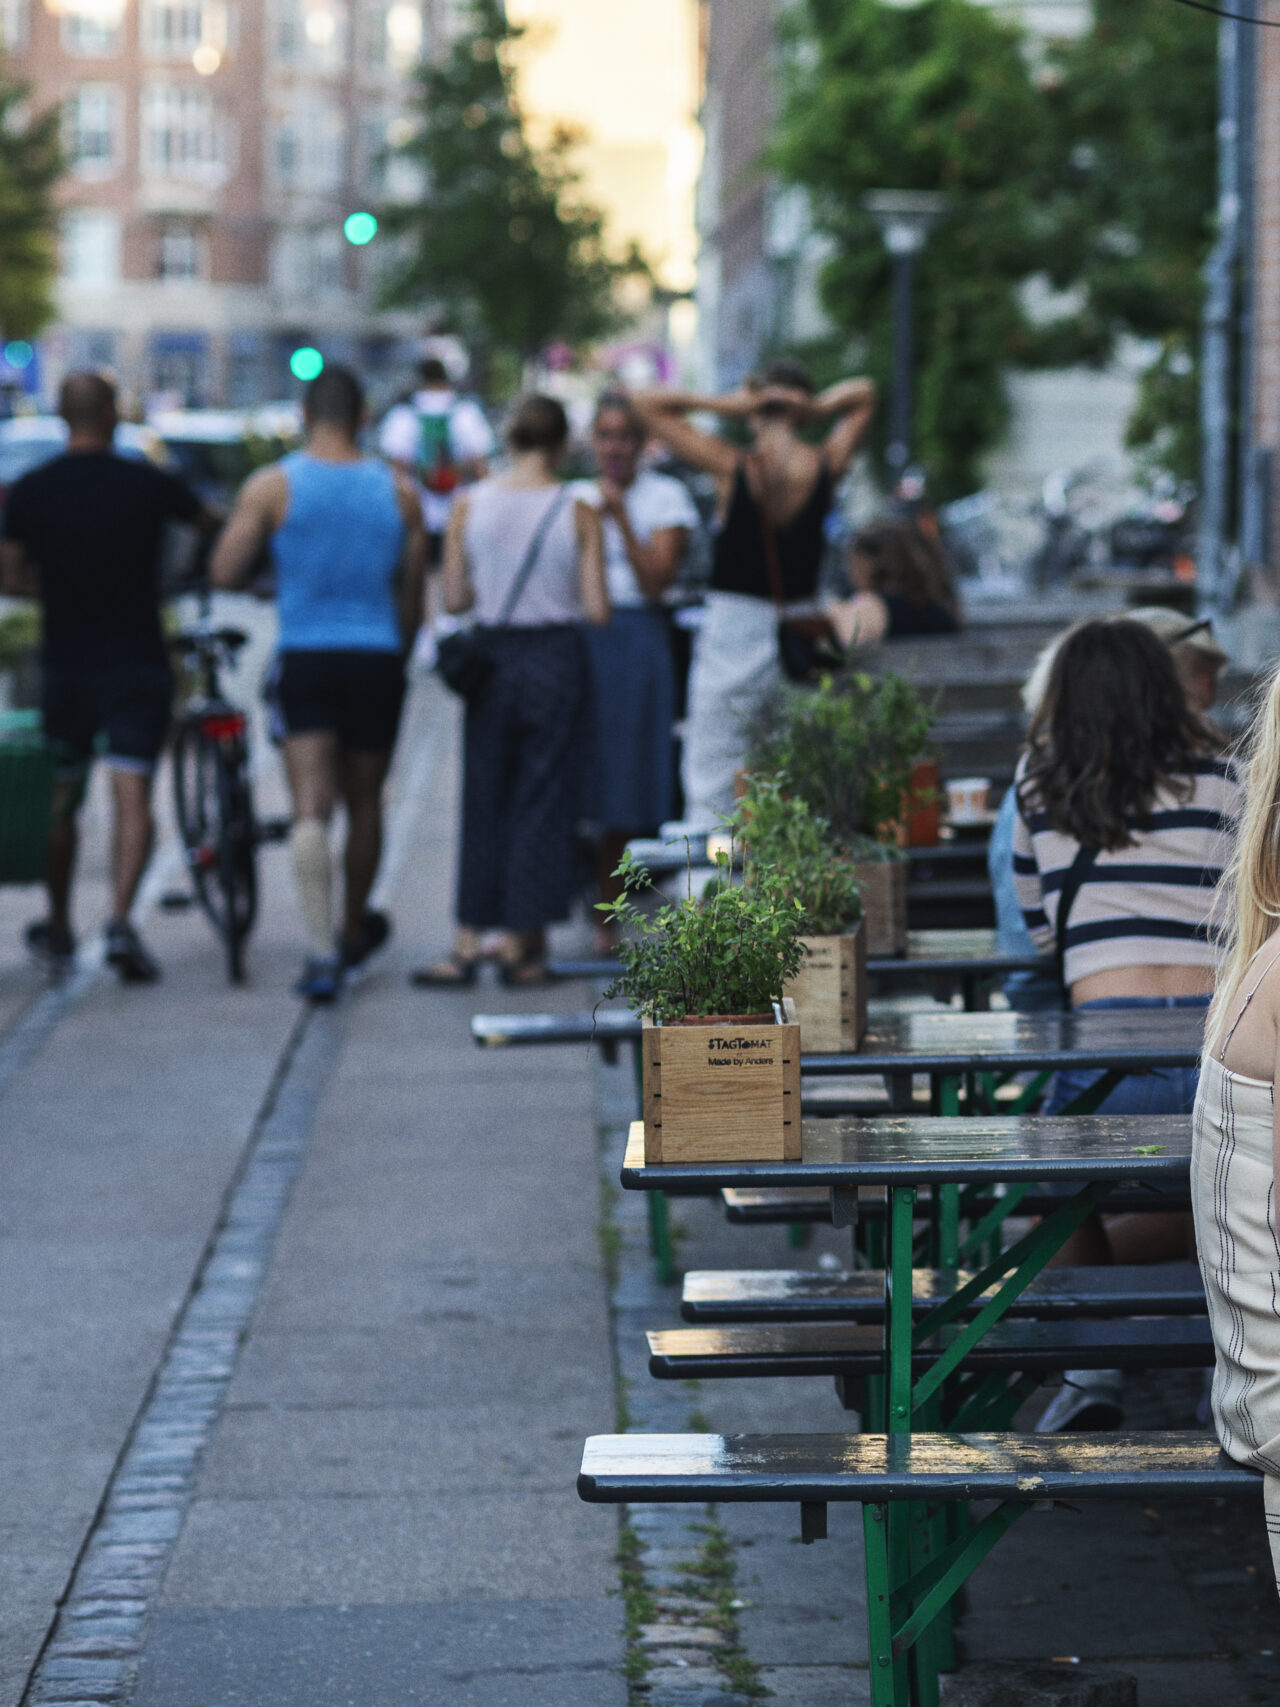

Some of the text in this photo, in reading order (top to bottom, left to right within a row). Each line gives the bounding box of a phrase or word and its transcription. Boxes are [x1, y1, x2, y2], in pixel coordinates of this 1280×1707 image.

[708, 1057, 774, 1067] Made by Anders
